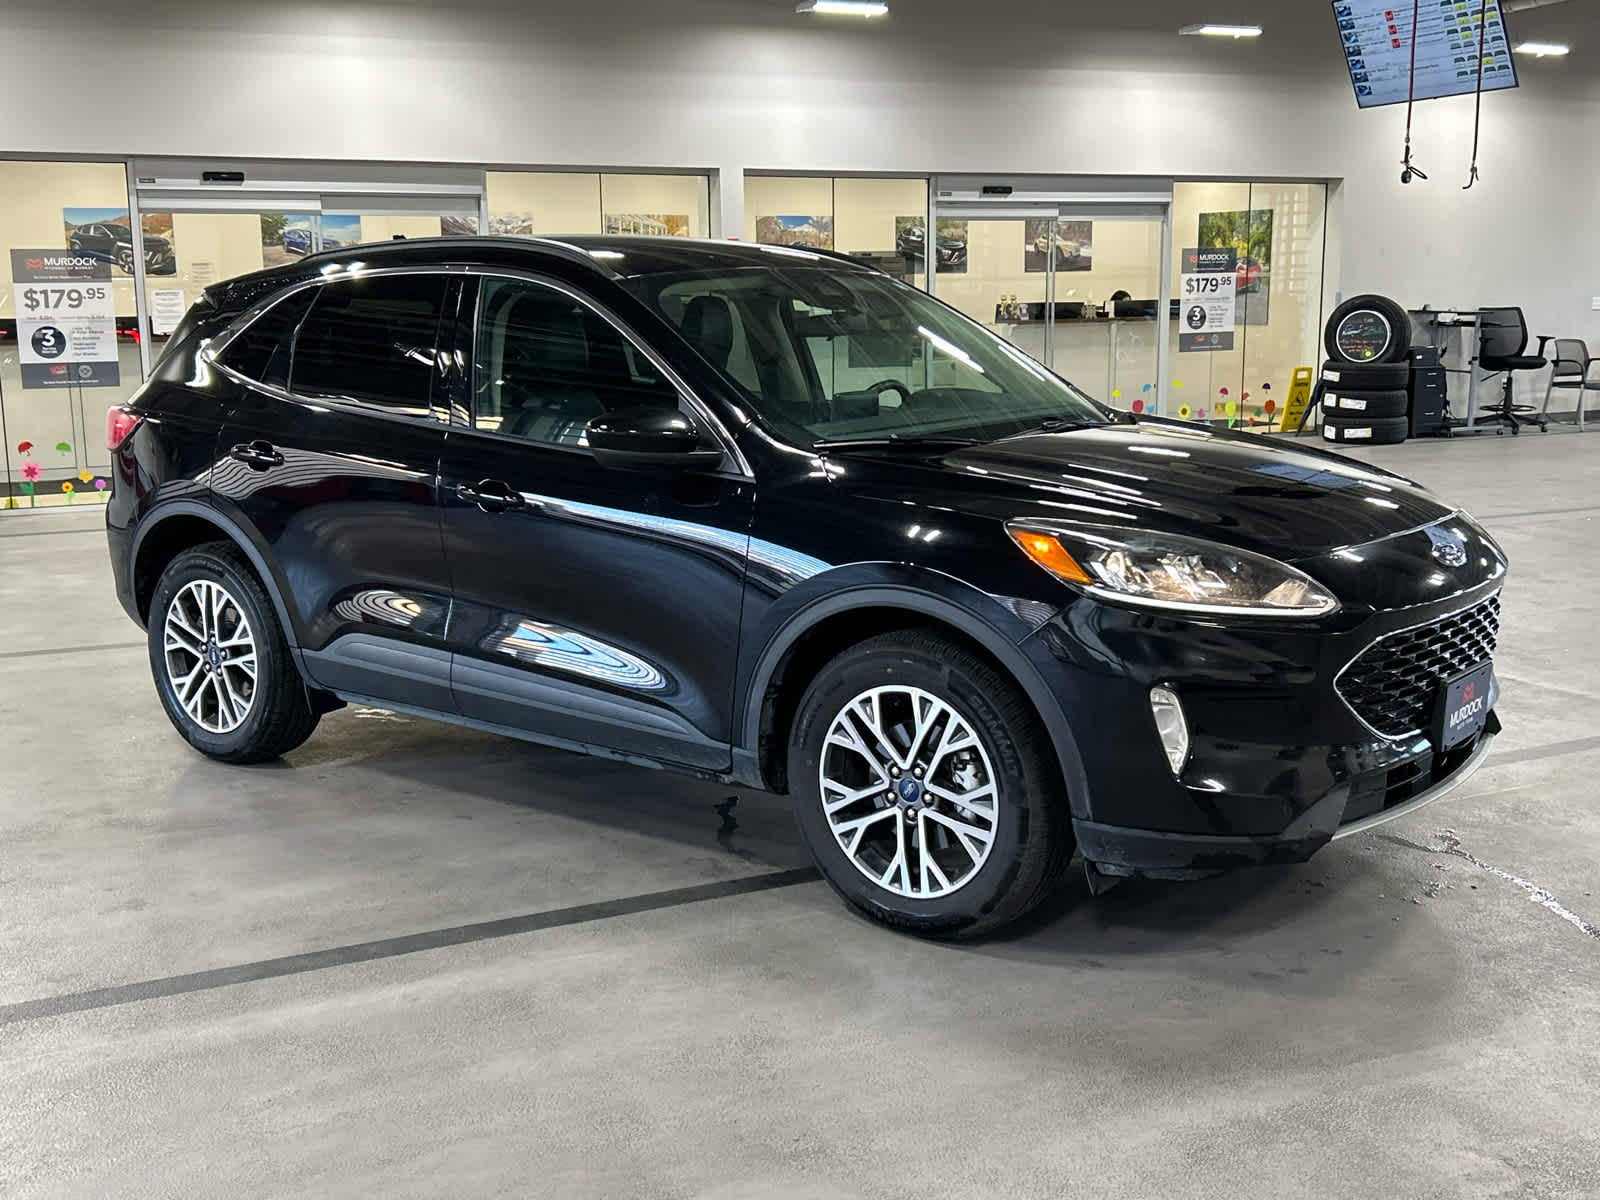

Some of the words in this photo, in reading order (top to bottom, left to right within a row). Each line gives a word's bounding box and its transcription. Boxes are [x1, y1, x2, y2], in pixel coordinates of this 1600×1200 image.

[43, 257, 97, 266] MURDOCK
[1192, 307, 1201, 320] 3
[41, 329, 56, 346] 3
[1449, 696, 1483, 729] MURDOCK
